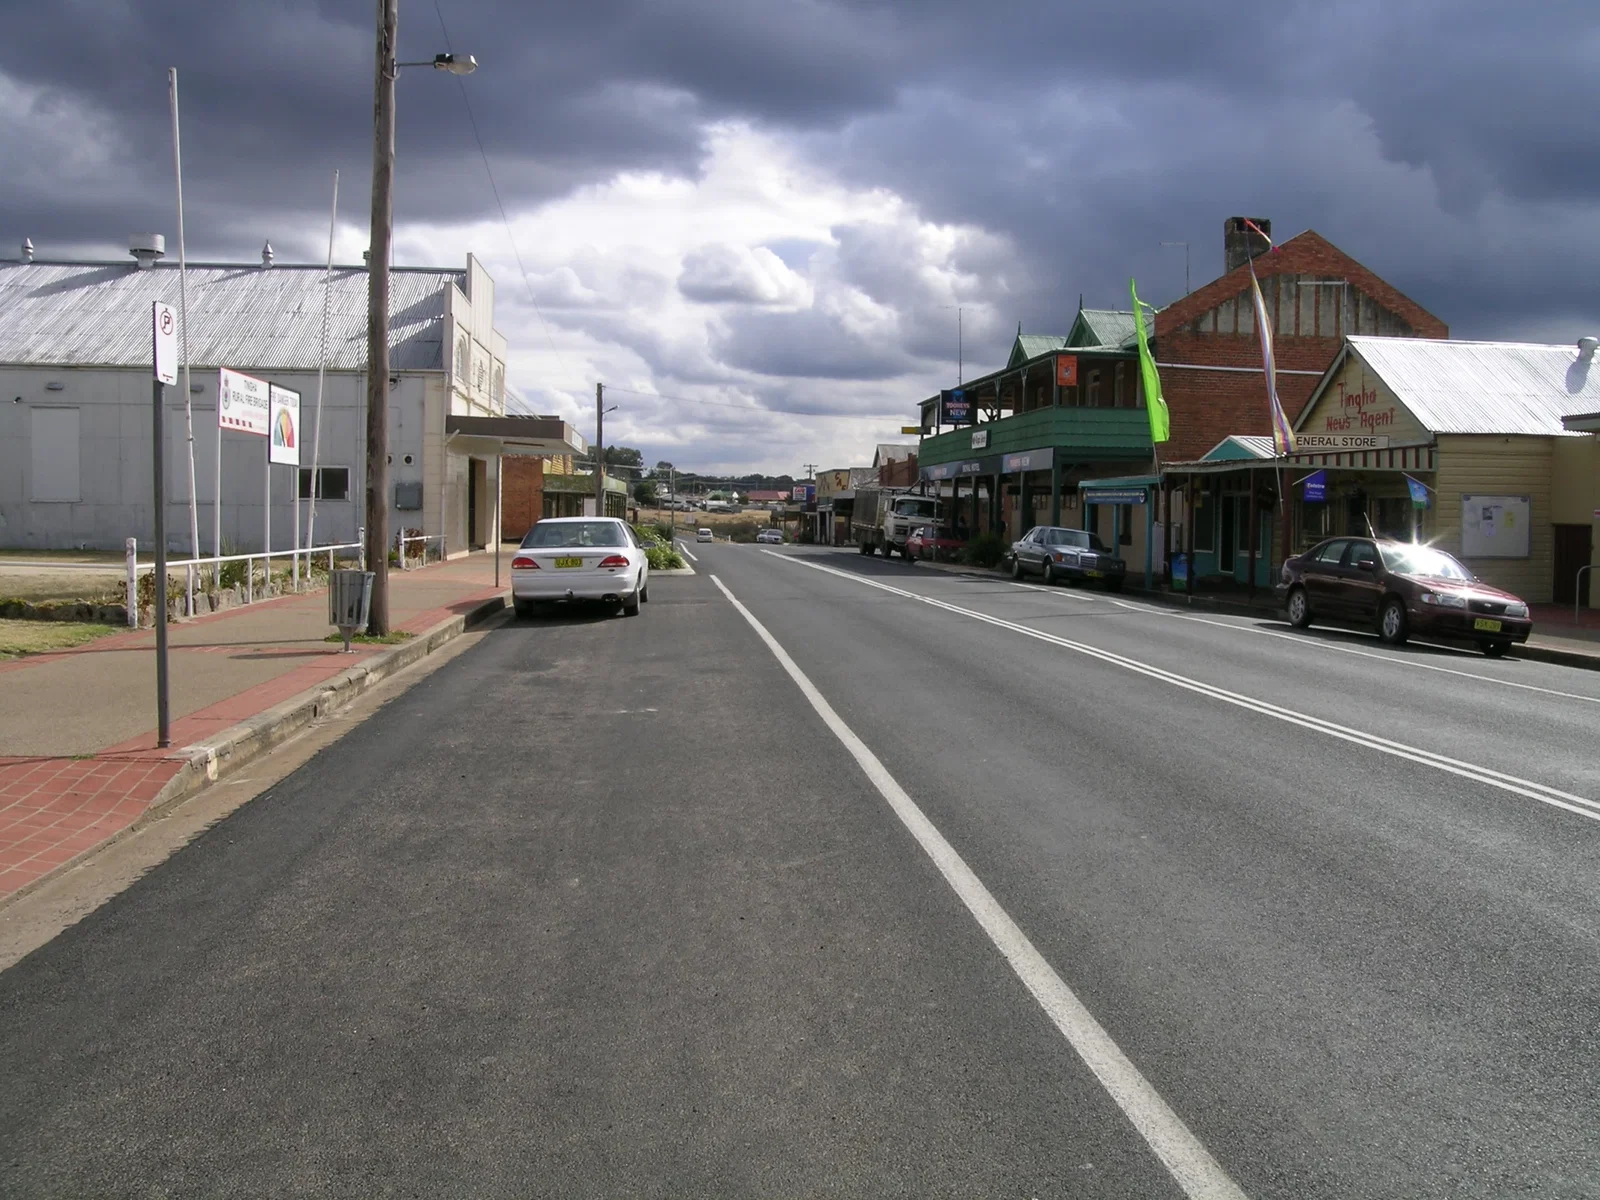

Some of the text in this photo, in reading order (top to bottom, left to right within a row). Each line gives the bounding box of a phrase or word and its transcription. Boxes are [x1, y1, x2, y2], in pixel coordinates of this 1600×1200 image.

[1337, 382, 1376, 414] Tingha
[1326, 416, 1351, 431] News
[1296, 436, 1376, 446] ENERAL STORE
